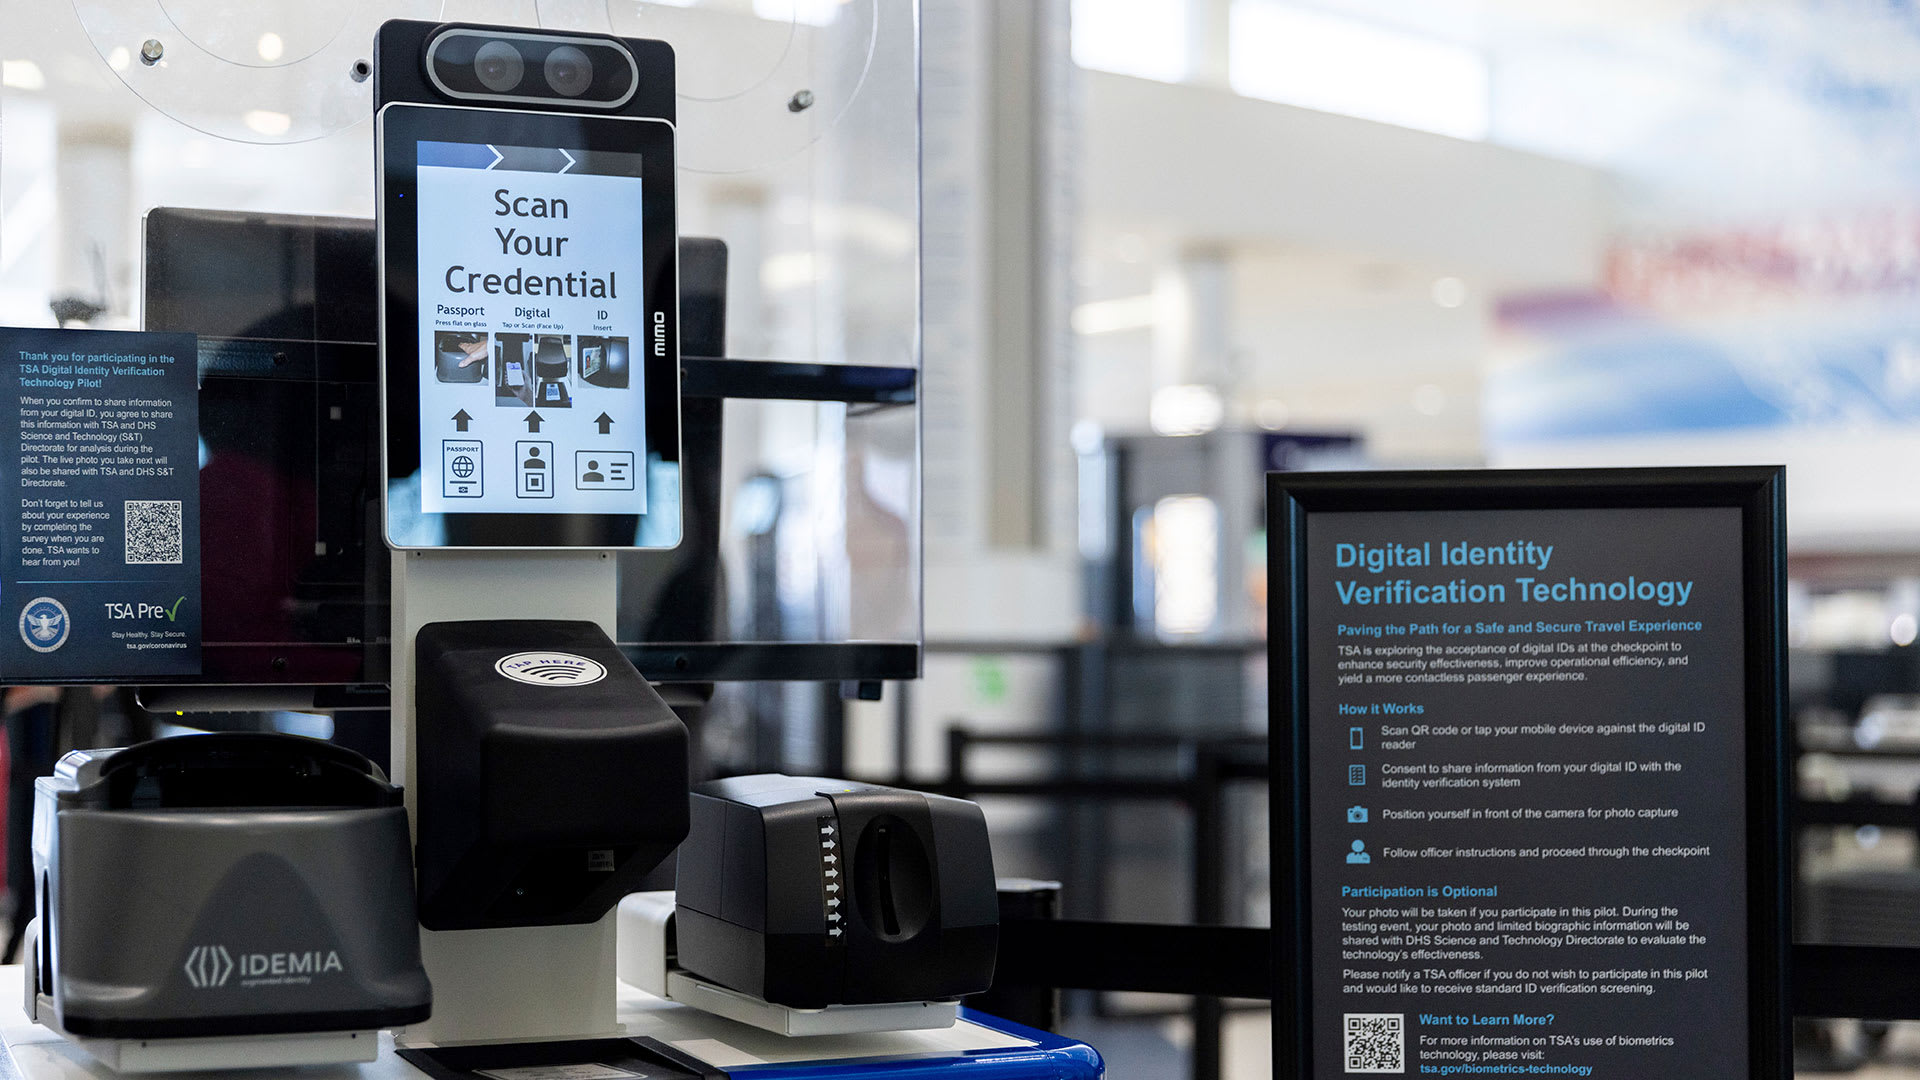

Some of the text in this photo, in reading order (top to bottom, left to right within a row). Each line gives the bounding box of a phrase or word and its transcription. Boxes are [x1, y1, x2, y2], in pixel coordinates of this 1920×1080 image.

[494, 189, 568, 219] Scan
[494, 227, 569, 257] Your
[445, 265, 617, 299] Credential
[437, 304, 485, 317] Passport
[514, 307, 550, 320] Digital
[598, 310, 608, 320] ID
[19, 351, 174, 364] Thank you for participating in the
[19, 364, 164, 377] TSA Digital Identity Verification
[19, 377, 101, 389] Technology Pilot!
[20, 396, 172, 407] When you confirm to share information
[20, 419, 35, 428] this
[37, 420, 81, 429] information
[101, 420, 119, 429] TSA
[120, 421, 135, 429] and
[137, 421, 156, 429] DHS
[20, 431, 142, 442] Science and Technology (S&T)
[21, 443, 65, 452] Directorate
[66, 443, 77, 452] for
[79, 444, 112, 454] analysis
[113, 444, 138, 454] during
[21, 478, 67, 487] Directorate.
[21, 498, 43, 507] Don't
[44, 499, 68, 509] forget
[80, 499, 92, 507] tell
[21, 510, 110, 521] about your experience
[21, 522, 92, 532] by completing the
[21, 545, 99, 554] done. TSA wants to
[1336, 540, 1553, 573] Digital Identity
[1335, 576, 1693, 607] Verification Technology
[105, 603, 163, 619] TSA Pre
[151, 631, 163, 639] Stay
[1338, 619, 1702, 638] Paving the Path for a Safe and Secure Travel Experience
[506, 660, 532, 669] TAP
[1337, 655, 1688, 671] enhance security effectiveness, improve operational efficiency, and
[1338, 671, 1587, 685] yield a more contactless passenger experience.
[1339, 703, 1424, 714] How it Works
[1381, 739, 1416, 749] reader
[1382, 777, 1520, 790] identity verification system
[1383, 845, 1710, 859] Follow officer instructions and proceed through the checkpoint
[1342, 885, 1497, 899] Participation is Optional
[1342, 949, 1483, 961] technology's effectiveness.
[240, 951, 343, 976] IDEMIA
[1343, 982, 1655, 995] and would like to receive standard ID verification screening.
[1419, 1014, 1554, 1025] Want to Learn More?
[1420, 1035, 1674, 1045] For more information on TSA's use of biometrics
[1419, 1049, 1544, 1062] technology, please visit:
[1420, 1063, 1592, 1076] tsa.gov/biometrics-technology
